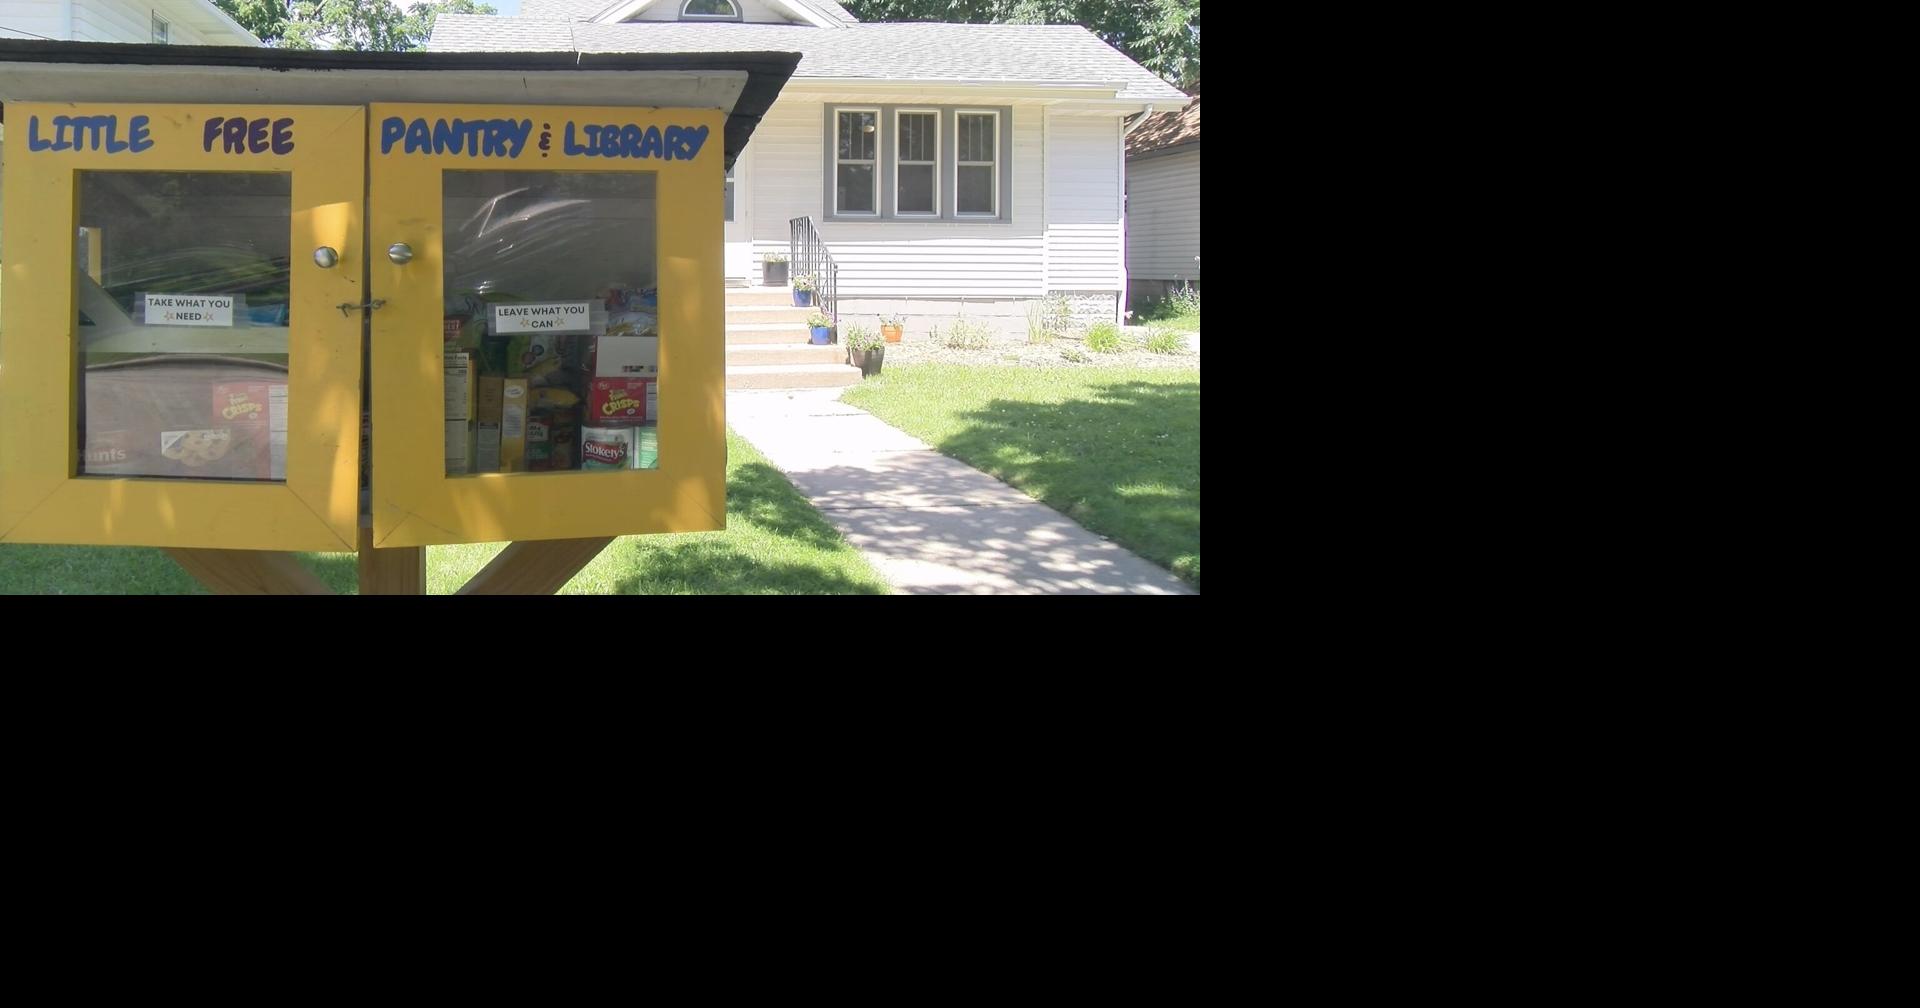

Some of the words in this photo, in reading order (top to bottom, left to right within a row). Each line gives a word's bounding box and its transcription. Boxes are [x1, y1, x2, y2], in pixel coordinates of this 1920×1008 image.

[28, 114, 154, 154] LITTLE
[203, 116, 295, 155] FREE
[381, 116, 533, 158] PANTRY
[563, 120, 709, 161] LIBRARY
[149, 298, 173, 306] TAKE
[176, 299, 206, 308] WHAT
[207, 300, 231, 308] YOU
[176, 312, 202, 321] NEED
[498, 307, 529, 317] LEAVE
[531, 305, 561, 316] WHAT
[563, 305, 585, 315] YOU
[531, 320, 554, 329] CAN
[585, 442, 625, 460] Stokely's
